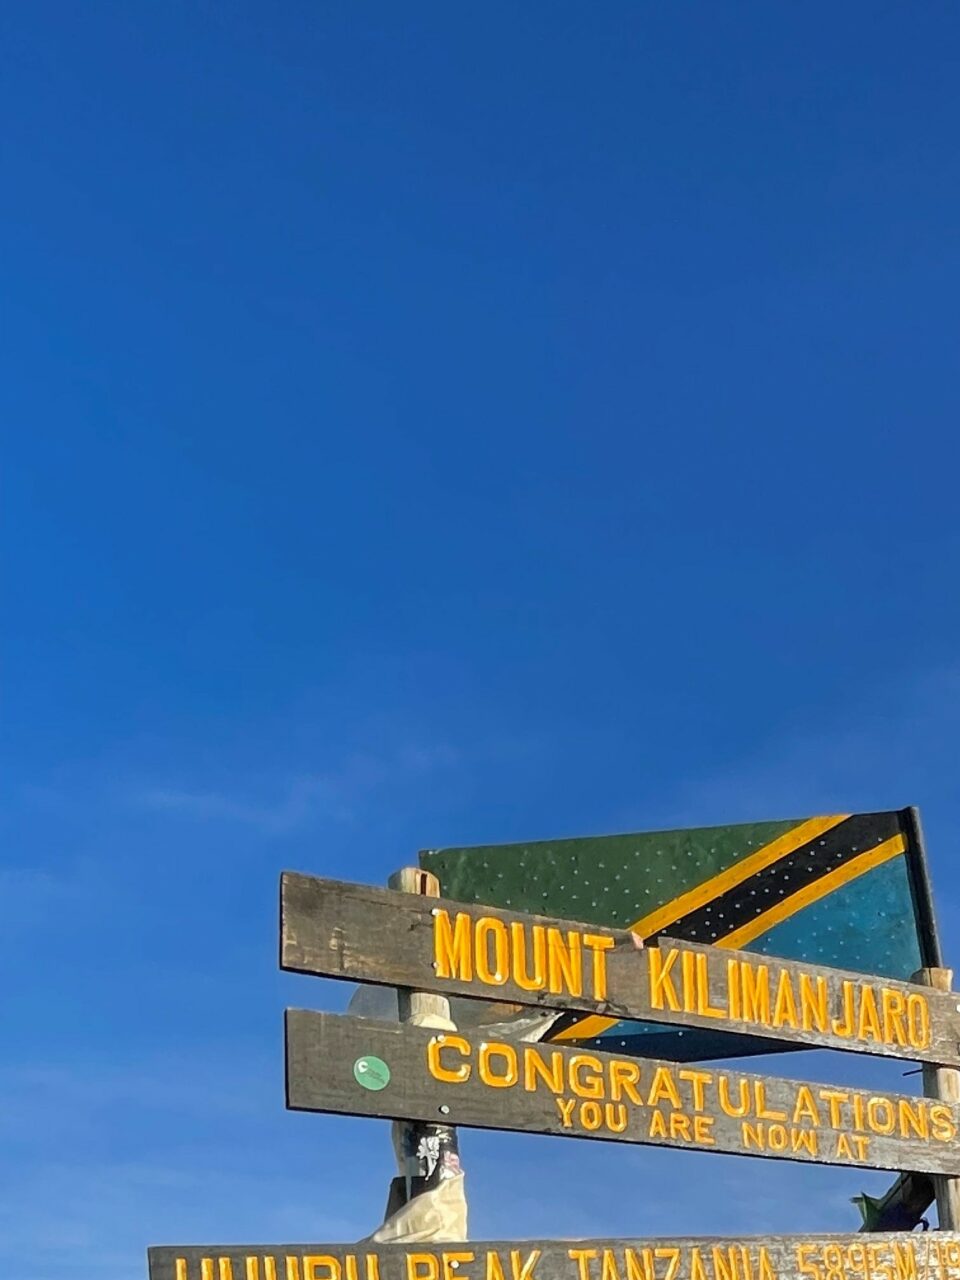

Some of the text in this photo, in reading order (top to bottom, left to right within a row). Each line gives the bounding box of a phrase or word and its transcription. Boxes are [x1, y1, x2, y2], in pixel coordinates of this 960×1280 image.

[434, 908, 931, 1051] MOUNT KILIMANJARO
[427, 1035, 958, 1142] CONGRATULATIONS
[556, 1098, 870, 1160] YOU ARE NOW AT
